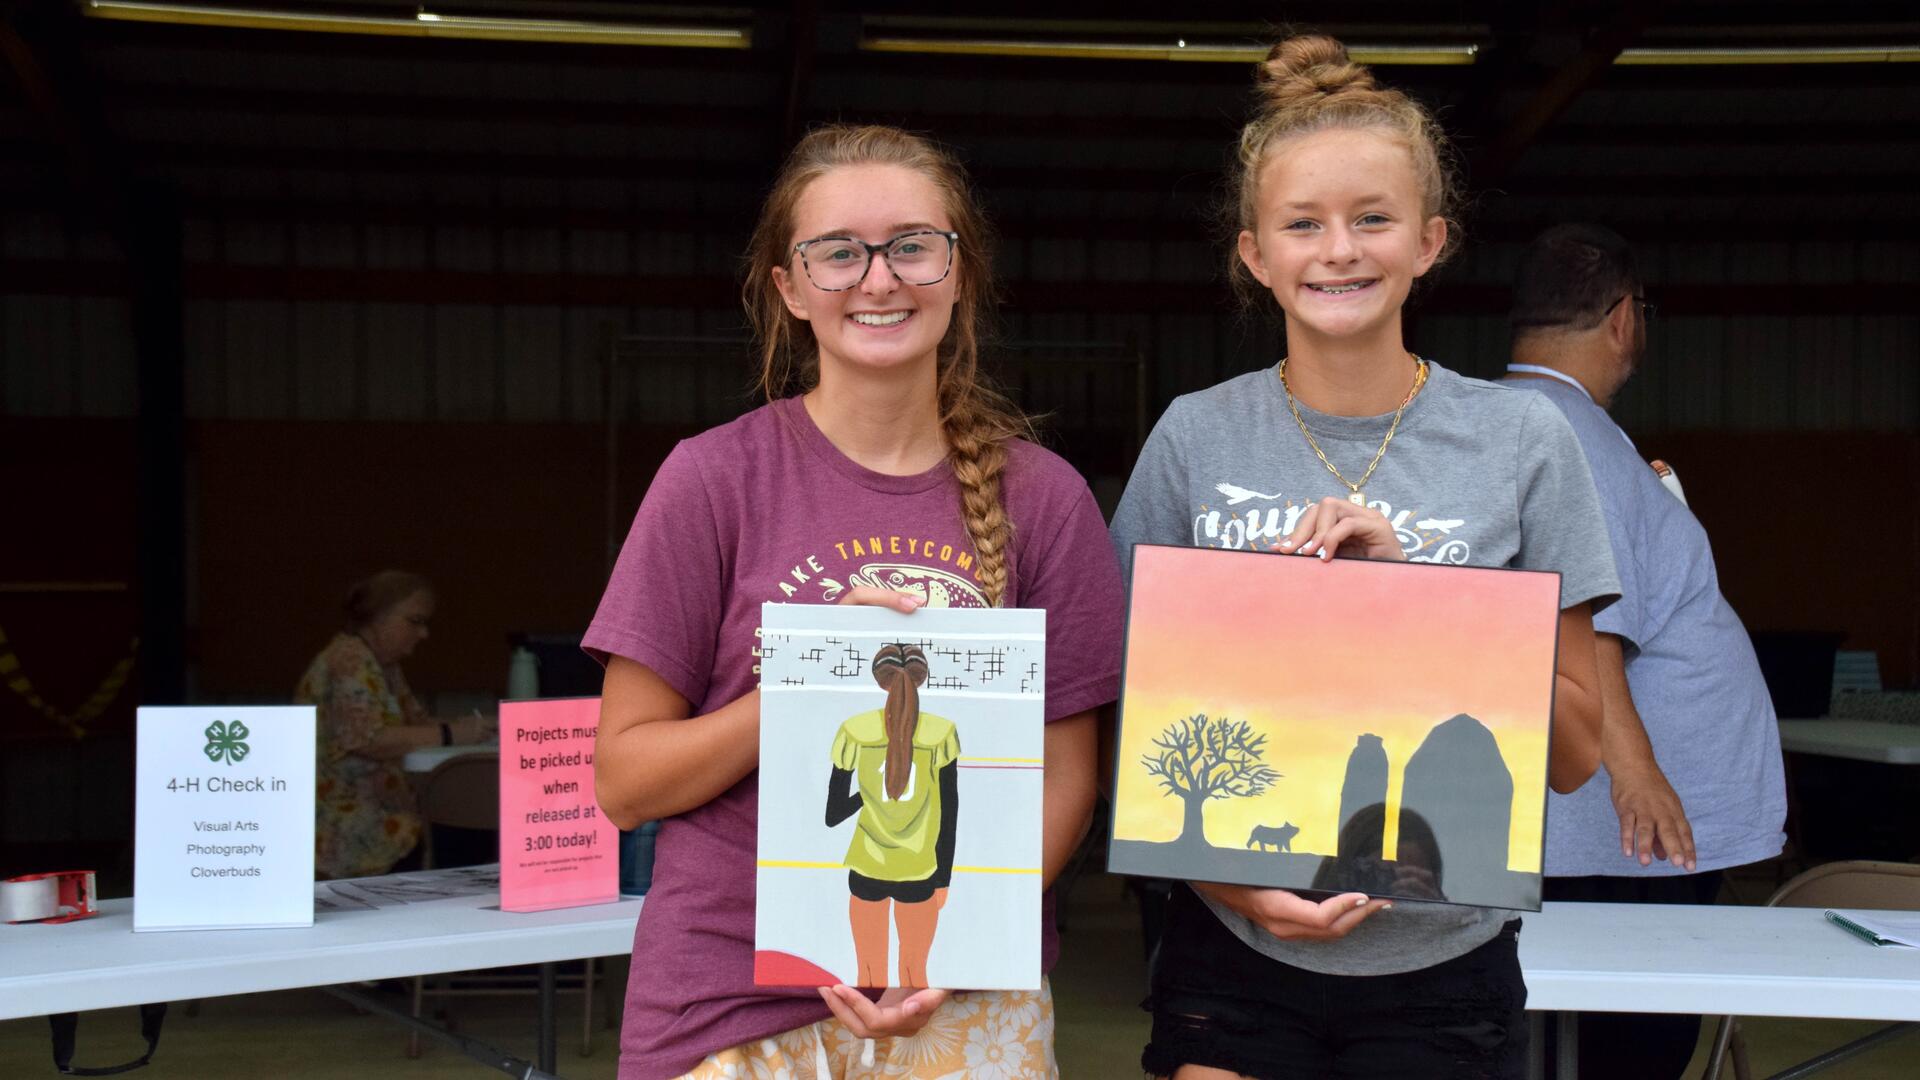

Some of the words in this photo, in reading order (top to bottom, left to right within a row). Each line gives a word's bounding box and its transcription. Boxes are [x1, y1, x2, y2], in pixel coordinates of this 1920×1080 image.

[767, 555, 825, 605] AKE
[517, 726, 569, 744] Projects
[572, 727, 599, 739] mus
[520, 754, 537, 769] be
[540, 750, 581, 772] picked
[166, 777, 200, 793] 4-H
[206, 777, 265, 793] Check
[271, 777, 287, 792] in
[543, 780, 579, 795] when
[526, 804, 580, 824] released
[583, 805, 597, 819] at
[193, 821, 232, 832] Visual
[234, 821, 259, 832] Arts
[525, 835, 553, 852] 3:00
[556, 830, 597, 849] today!
[186, 844, 266, 857] Photography
[190, 866, 261, 878] Cloverbuds
